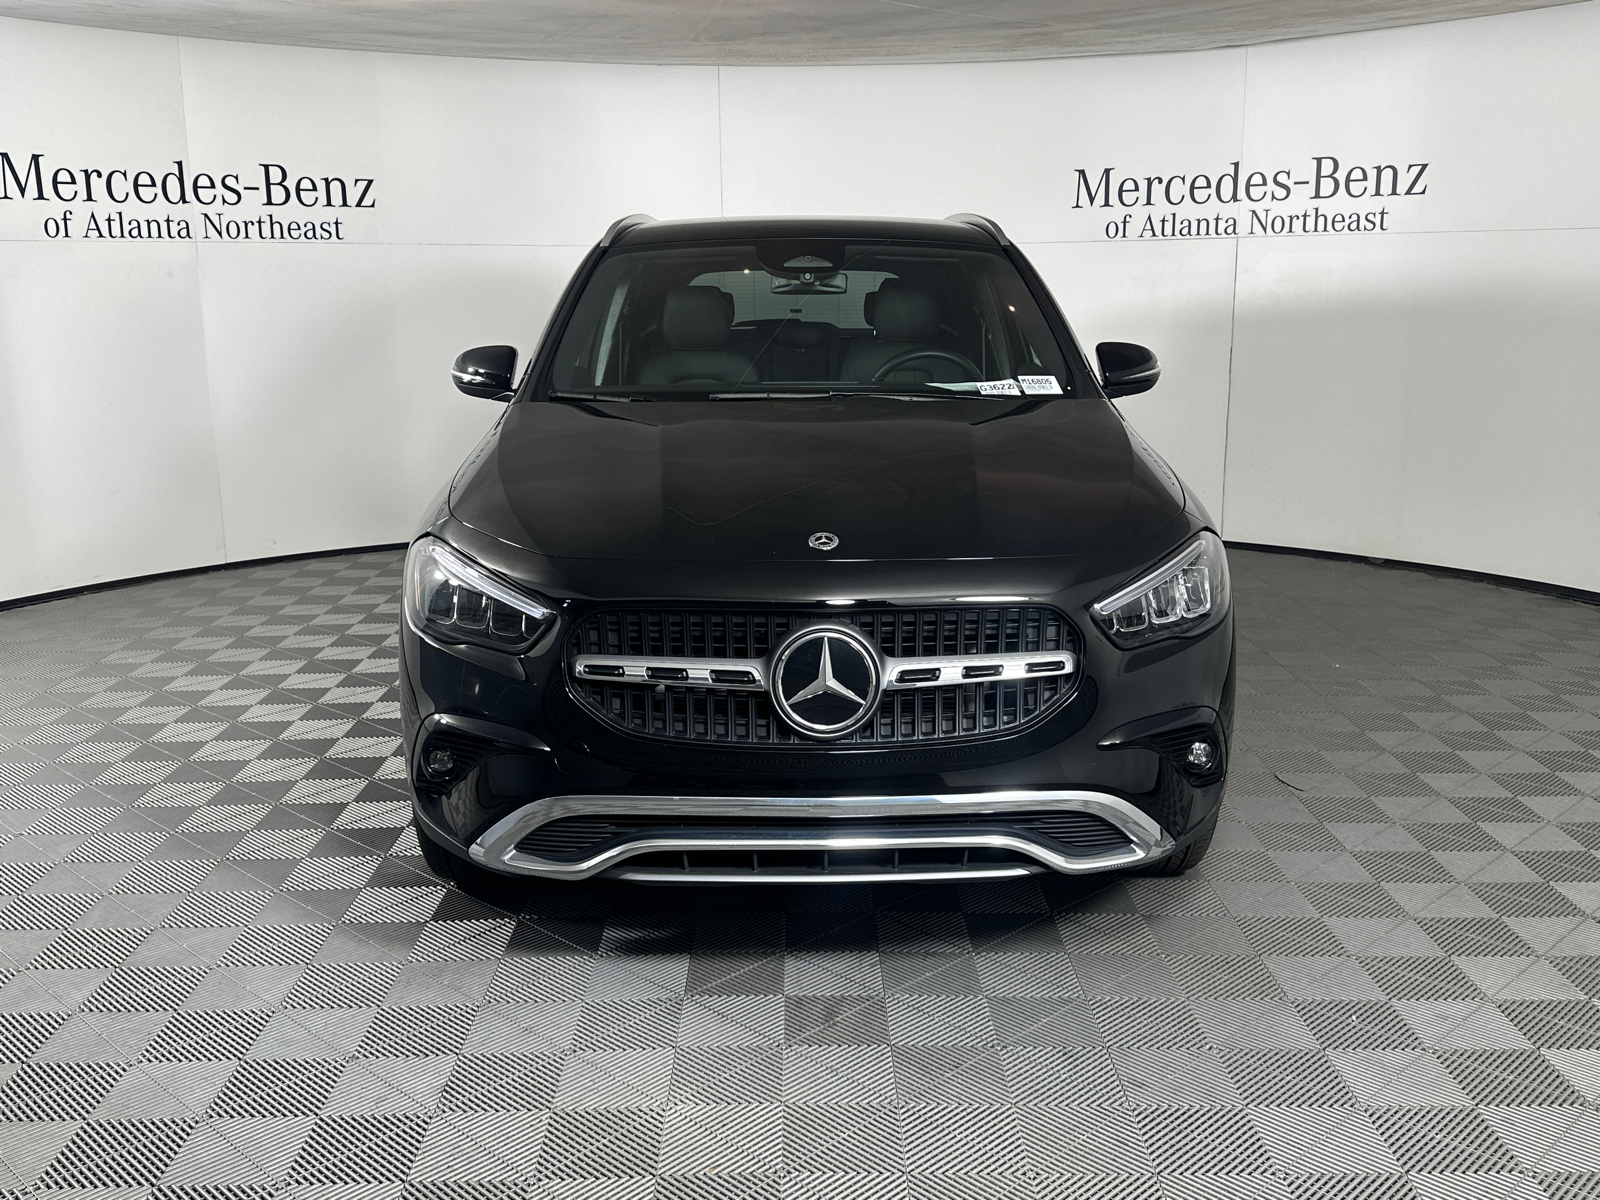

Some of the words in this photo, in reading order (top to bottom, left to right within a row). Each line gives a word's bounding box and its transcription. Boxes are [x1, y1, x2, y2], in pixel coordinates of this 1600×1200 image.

[0, 152, 376, 209] Mercedes-Benz
[1072, 156, 1429, 209] Mercedes-Benz
[43, 210, 73, 239] of
[83, 211, 193, 239] Atlanta
[201, 212, 345, 240] Northeast
[1105, 214, 1132, 239] of
[1138, 213, 1238, 238] Atlanta
[1248, 207, 1389, 236] Northeast
